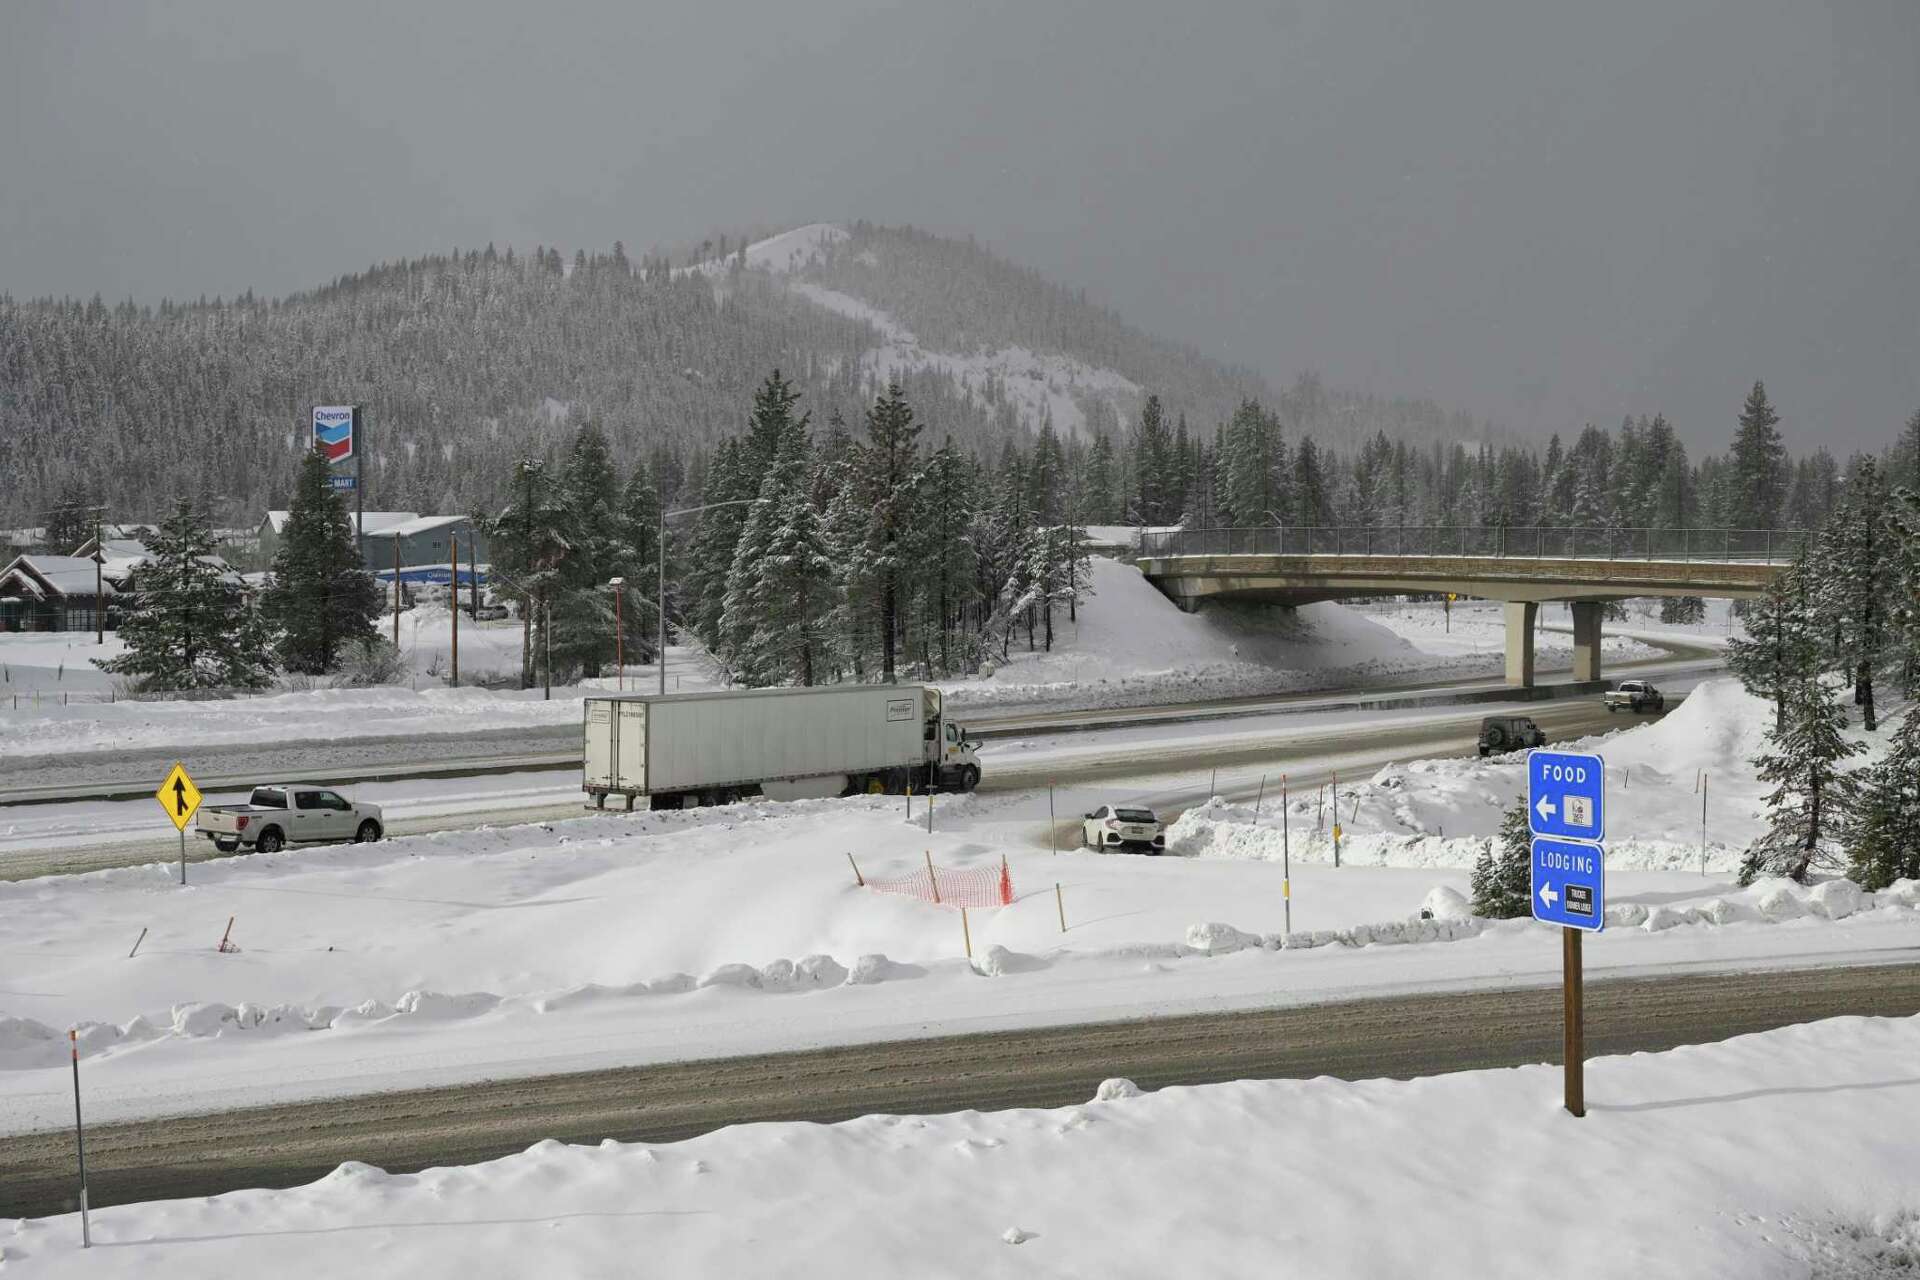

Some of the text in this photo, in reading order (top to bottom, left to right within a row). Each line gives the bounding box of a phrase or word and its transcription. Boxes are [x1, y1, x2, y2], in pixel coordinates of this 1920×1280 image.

[315, 411, 350, 420] Chevron
[1543, 764, 1586, 783] FOOD
[1541, 851, 1593, 874] LODGING
